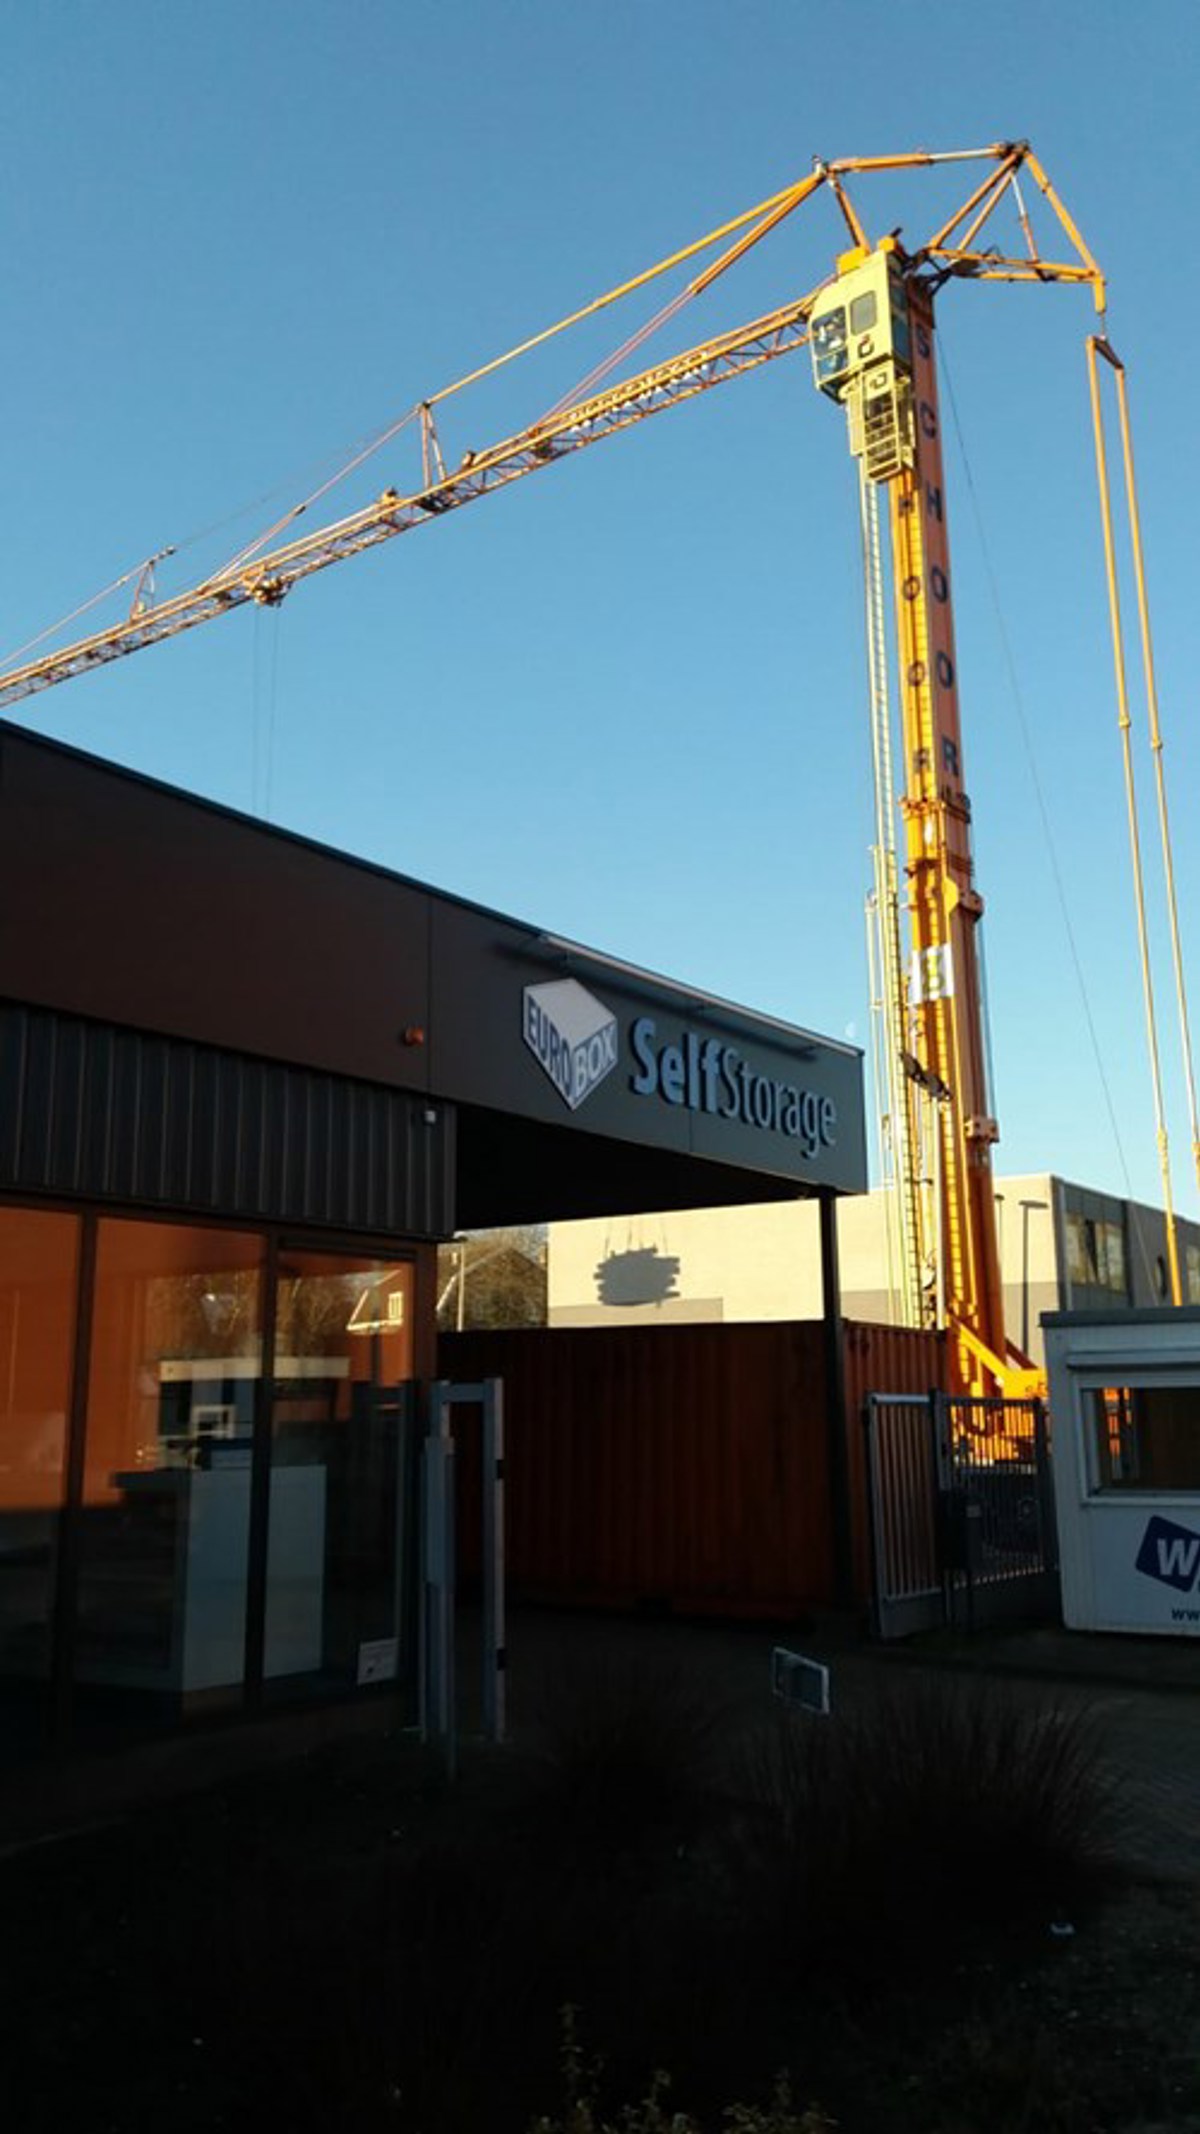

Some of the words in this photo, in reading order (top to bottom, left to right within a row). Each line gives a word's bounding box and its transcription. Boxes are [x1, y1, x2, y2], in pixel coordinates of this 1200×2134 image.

[527, 994, 572, 1098] EURO
[573, 1022, 618, 1099] BOX
[633, 1017, 836, 1158] SelfStorage
